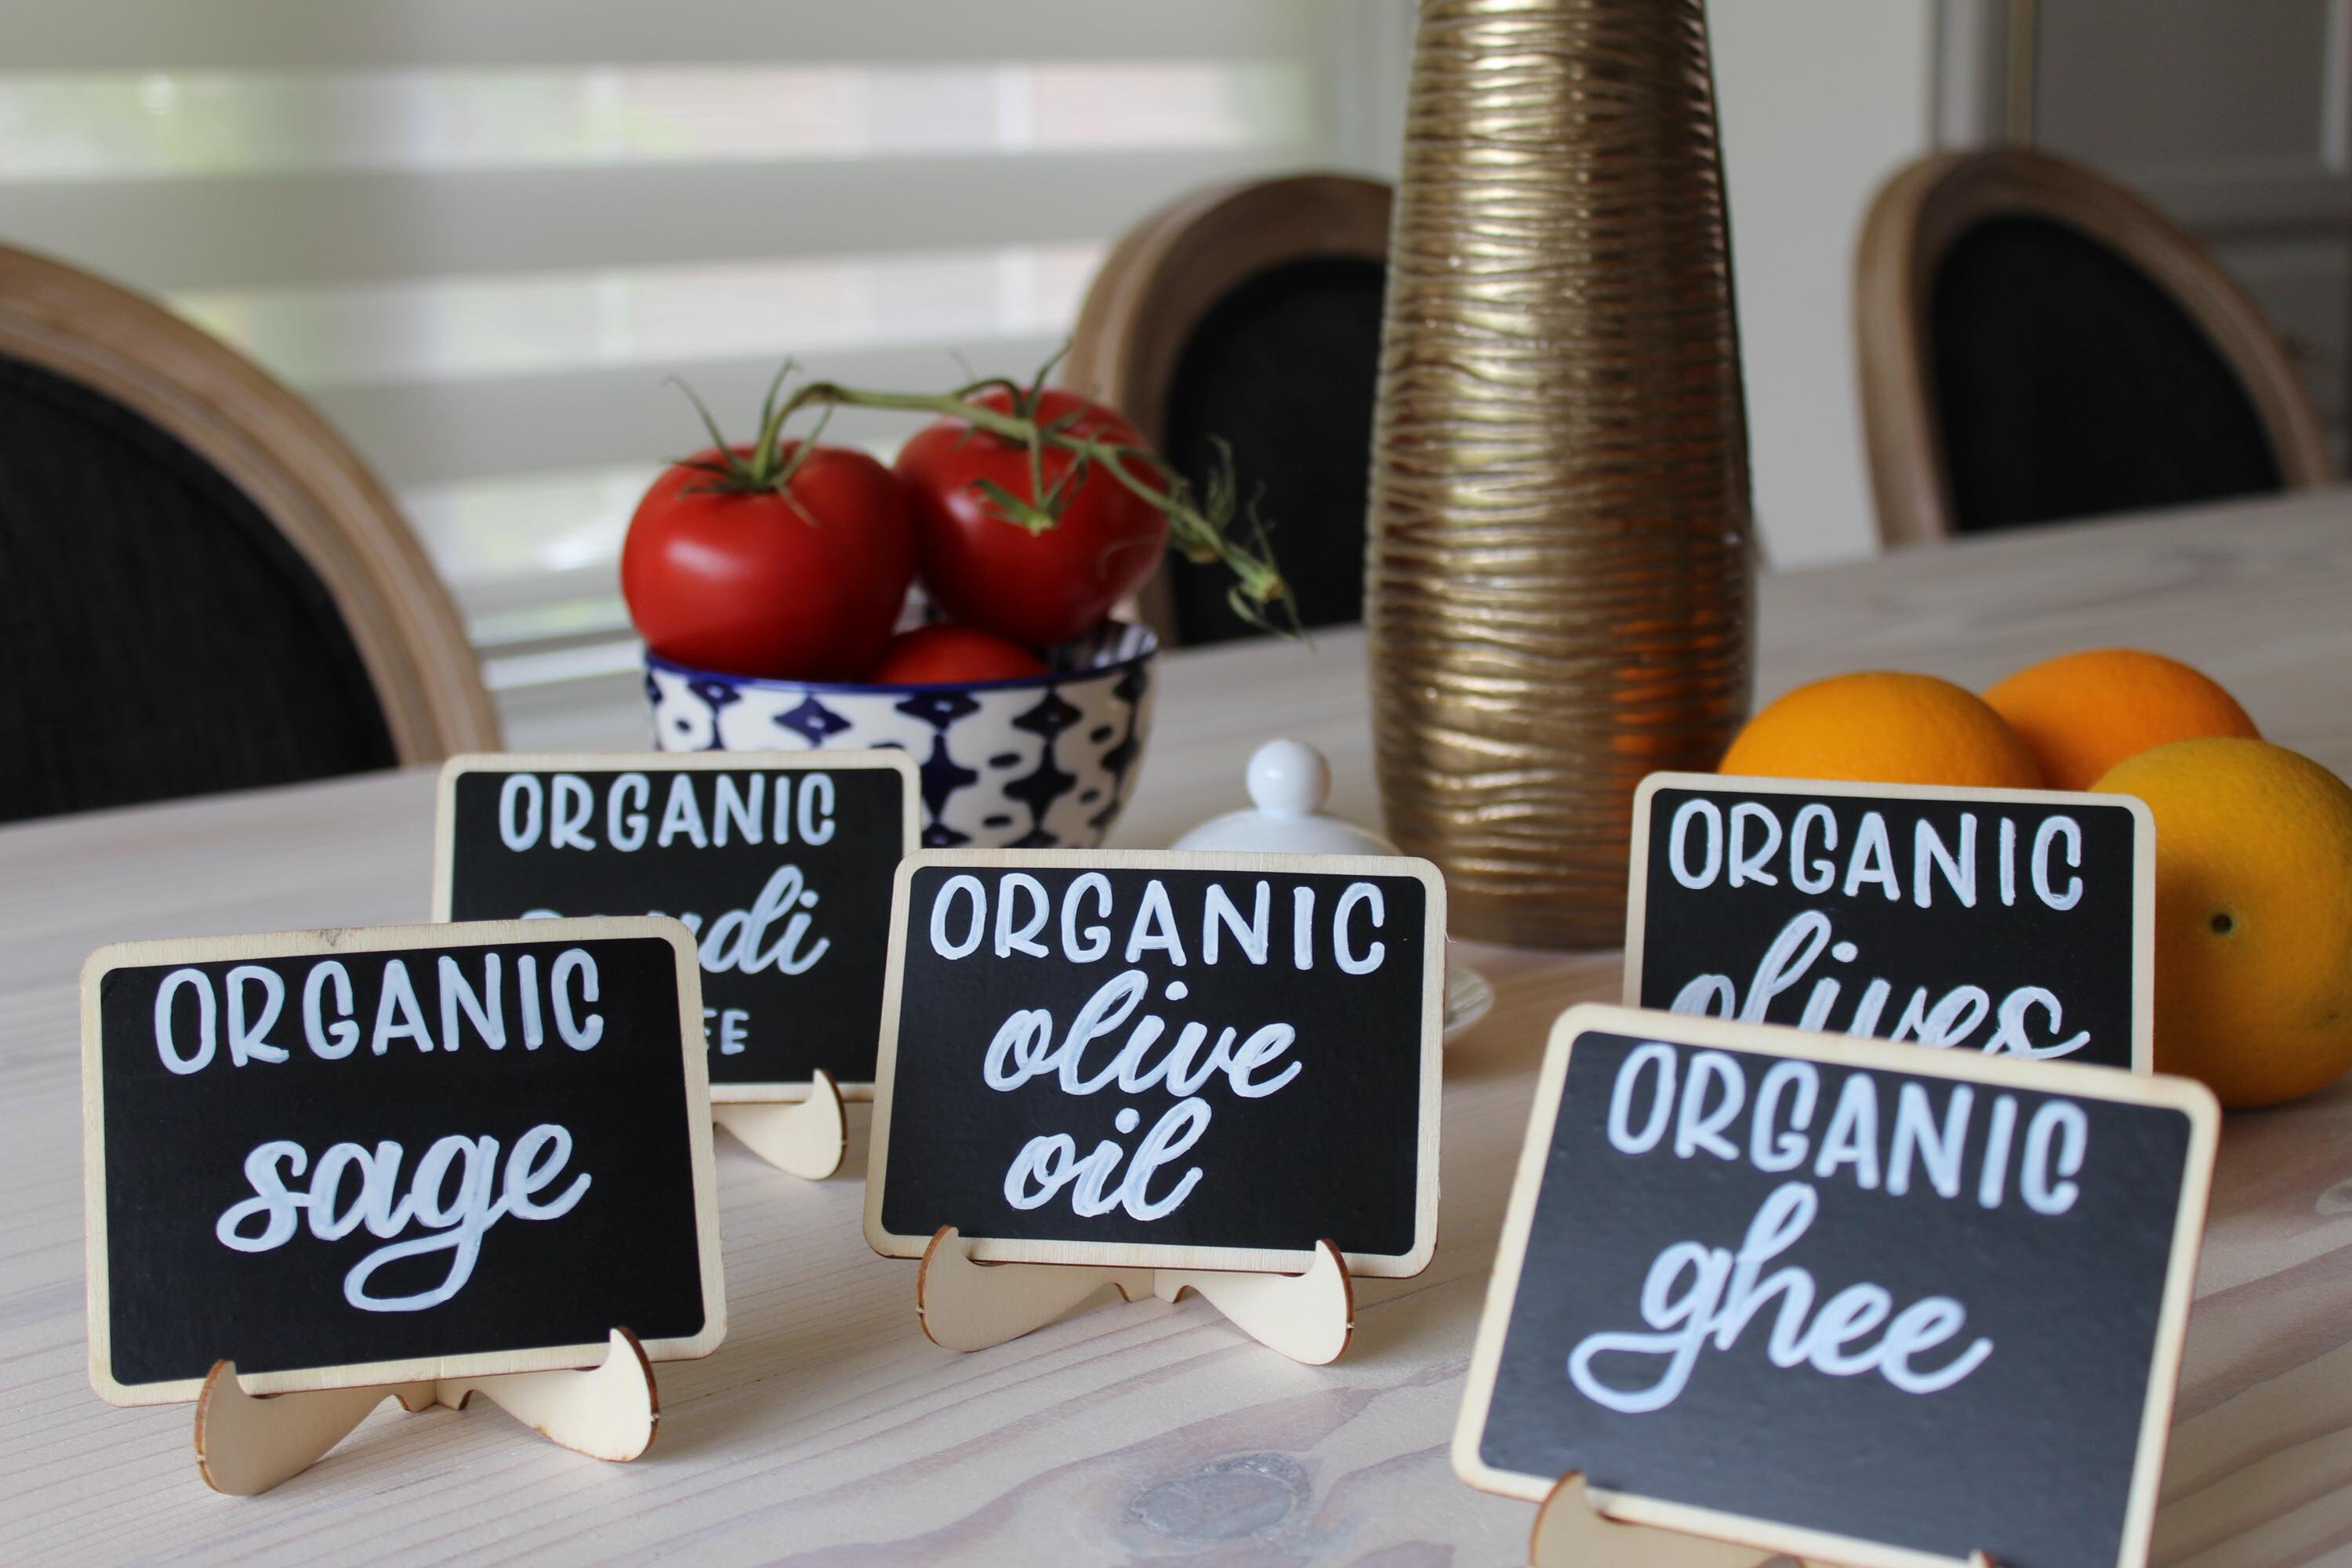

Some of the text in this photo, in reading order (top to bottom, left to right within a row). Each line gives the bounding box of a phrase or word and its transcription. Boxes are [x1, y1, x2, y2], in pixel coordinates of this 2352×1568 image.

[499, 773, 836, 852] ORGANIC
[1668, 798, 2084, 912] ORGANIC
[929, 872, 1386, 975] ORGANIC
[154, 948, 604, 1075] ORGANIC
[983, 969, 1302, 1098] olive
[1004, 1096, 1212, 1221] oil
[1607, 1042, 2088, 1214] ORGANIC
[216, 1123, 592, 1312] sage
[1567, 1181, 1994, 1414] ghee
